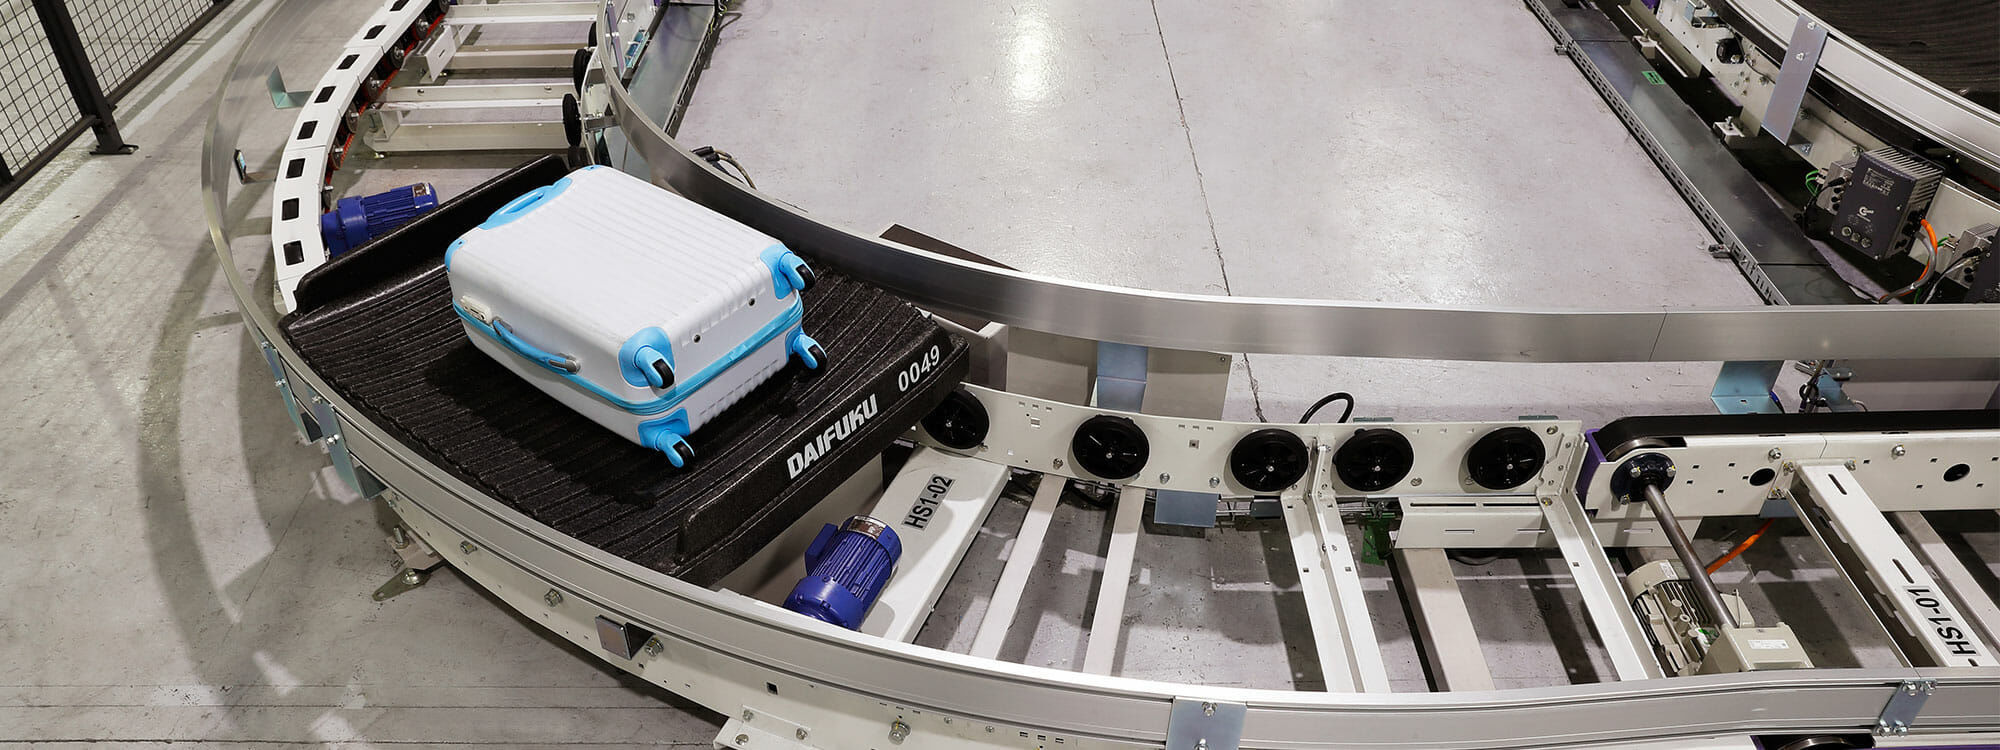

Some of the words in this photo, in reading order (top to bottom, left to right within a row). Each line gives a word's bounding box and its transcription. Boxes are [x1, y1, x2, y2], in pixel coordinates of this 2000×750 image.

[786, 393, 879, 480] DAIFUKU
[898, 345, 940, 392] 0049
[904, 476, 953, 529] HS1-02
[1906, 588, 1977, 655] HS1-01
